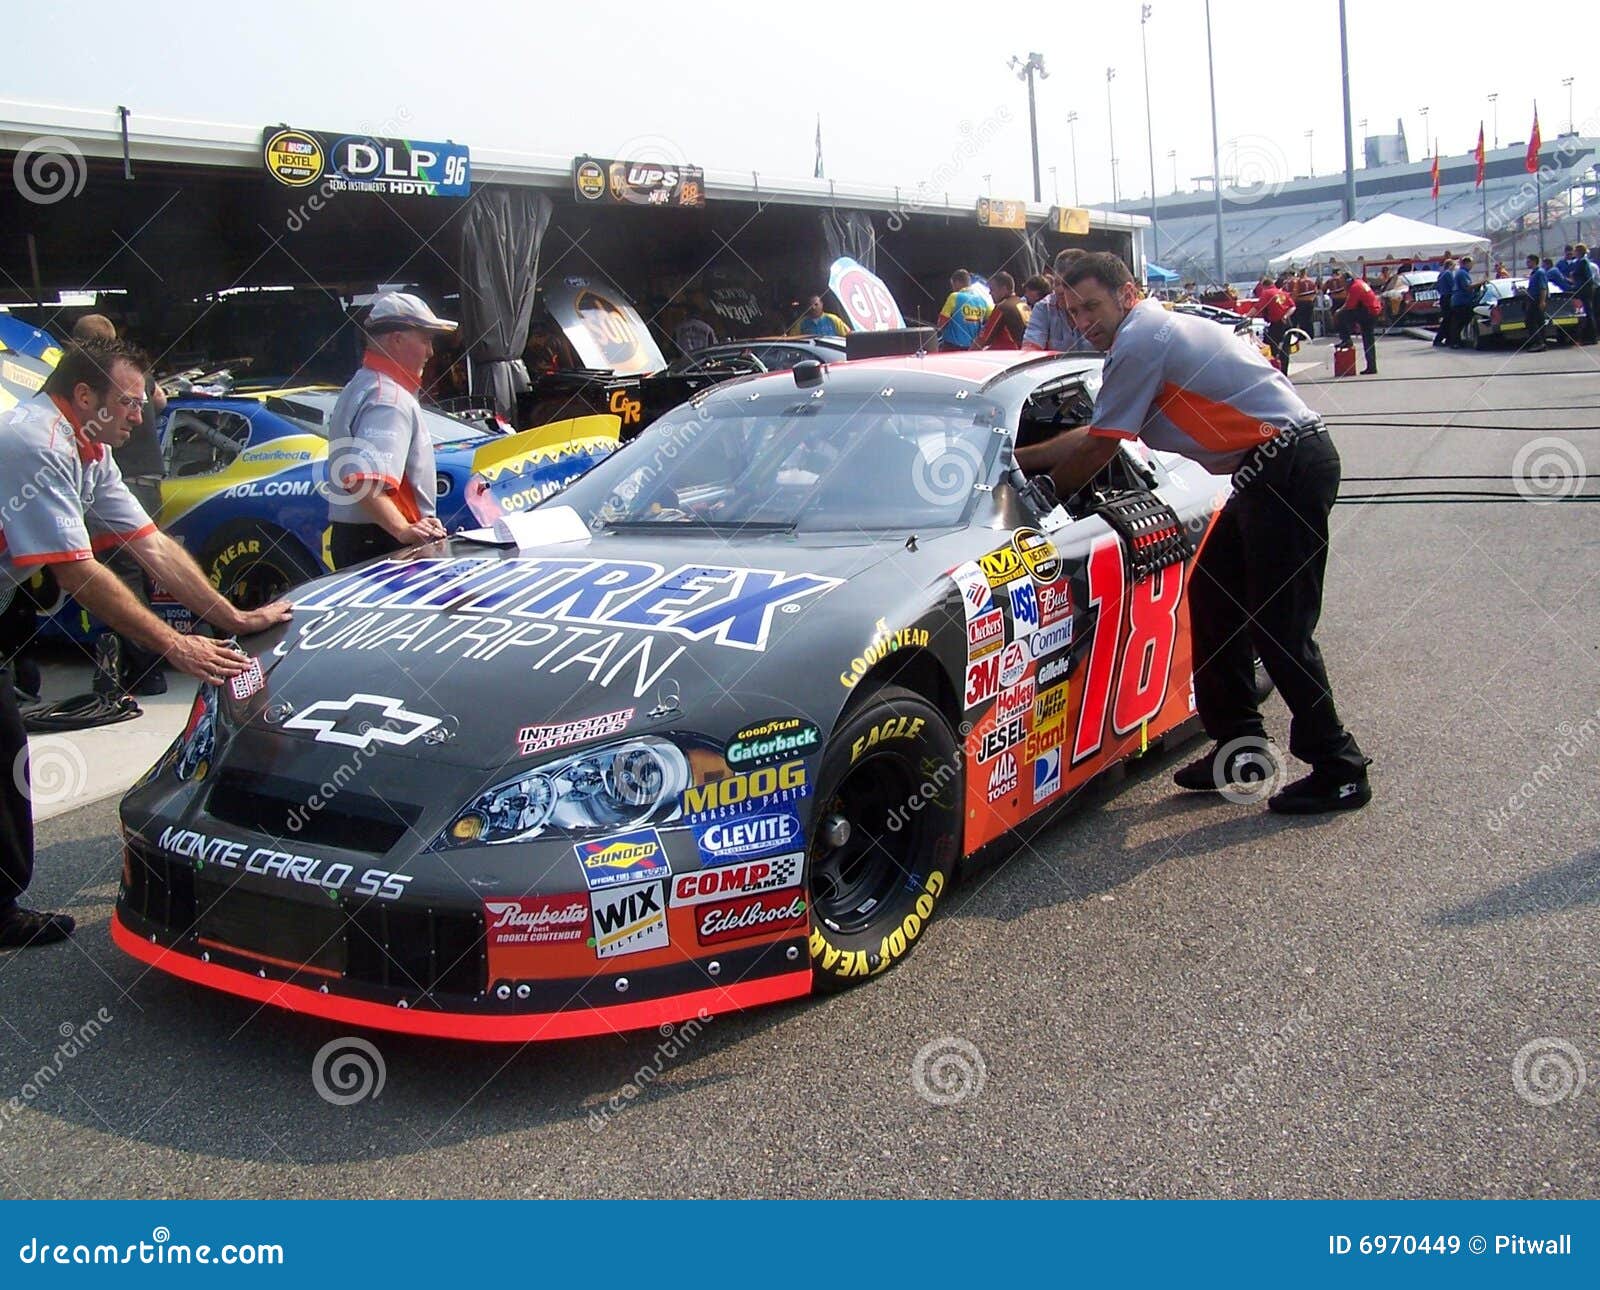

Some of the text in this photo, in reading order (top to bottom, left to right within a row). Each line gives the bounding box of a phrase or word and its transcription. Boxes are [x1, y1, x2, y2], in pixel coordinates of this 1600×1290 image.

[278, 153, 312, 167] NEXTEL
[288, 141, 313, 154] NASCAR
[347, 144, 437, 177] DLP
[443, 155, 467, 185] 96
[628, 168, 679, 187] UPS
[329, 180, 387, 193] TEXAS INSTRUMENTS
[390, 182, 436, 196] HDTV
[681, 181, 698, 201] 88
[610, 391, 640, 424] C&R
[243, 451, 300, 462] CertainTeed
[502, 496, 526, 512] GO
[525, 489, 543, 505] TO
[290, 558, 847, 651] IMITREX
[1010, 583, 1037, 625] USG
[1040, 583, 1068, 613] Bud
[166, 609, 192, 618] BOSCH
[969, 616, 1002, 643] Checkers
[1031, 620, 1073, 658] Commit
[273, 611, 686, 698] SUMATRIPTAN
[840, 626, 930, 689] GOODYEAR
[1004, 644, 1023, 670] EA
[1072, 532, 1186, 767] 18
[966, 655, 1000, 705] 3M
[1002, 663, 1024, 683] SPORTS
[1039, 657, 1069, 685] Gillette
[998, 683, 1034, 711] Holley
[1044, 688, 1063, 705] Auto
[1044, 699, 1066, 719] Meter
[519, 708, 634, 743] INTERSTATE
[523, 720, 626, 754] BATTERIES
[737, 718, 799, 739] GOODYEAR
[850, 716, 926, 764] EAGLE
[977, 717, 1027, 762] JESEL
[1026, 718, 1065, 760] Stant
[728, 729, 817, 763] Gatorback
[755, 750, 799, 766] BELTS
[988, 752, 1018, 791] MAC
[684, 760, 807, 816] MOOG
[987, 777, 1018, 803] TOOLS
[1034, 781, 1060, 801] DIRECTV
[691, 785, 807, 824] CHASSIS PARTS
[704, 814, 790, 851] CLEVITE
[159, 826, 414, 900] MONTE CARLO SS
[590, 844, 654, 866] SUNOCO
[676, 863, 771, 899] COMP
[741, 877, 788, 893] CAMS
[485, 902, 588, 932] Raybestos
[594, 884, 661, 935] WIX
[700, 896, 803, 936] Edelbrock
[809, 869, 944, 977] GOODYEAR
[496, 930, 582, 943] ROOKIE CONTENDER
[600, 921, 664, 955] FILTERS
